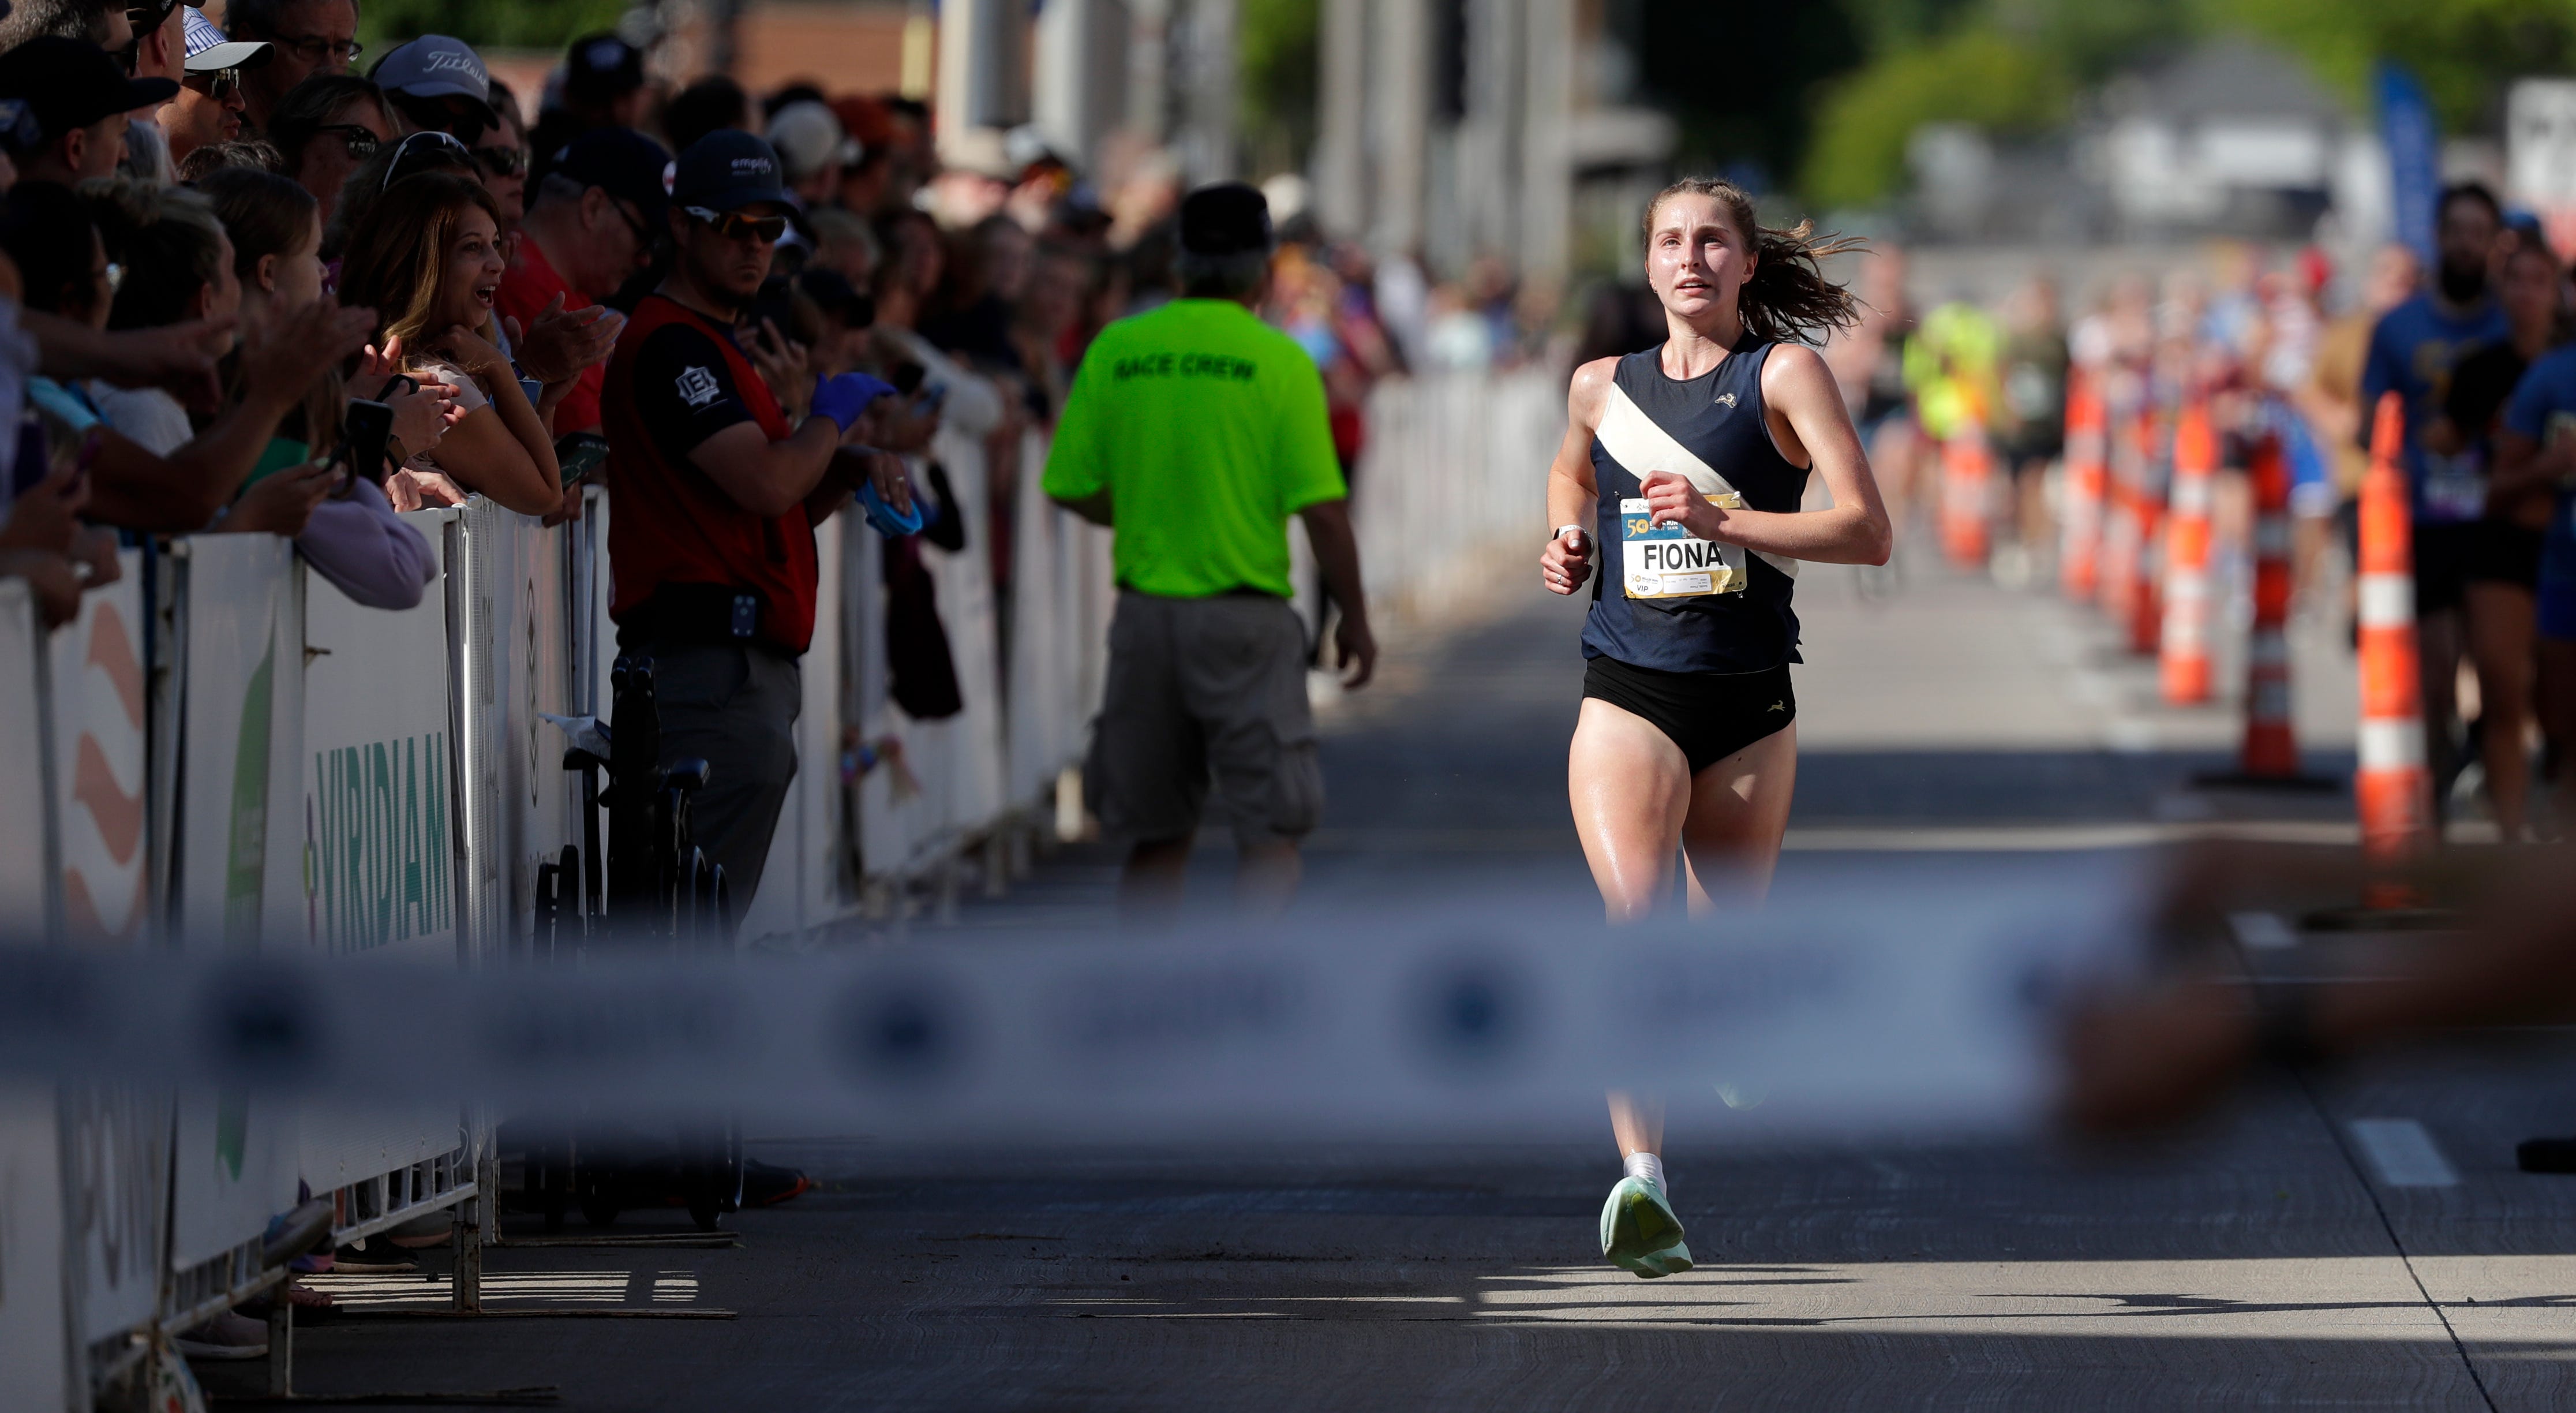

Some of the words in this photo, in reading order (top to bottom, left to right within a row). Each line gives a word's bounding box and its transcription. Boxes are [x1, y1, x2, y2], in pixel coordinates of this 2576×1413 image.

[1114, 353, 1174, 382] RACE
[1181, 353, 1257, 382] CREW
[1643, 541, 1724, 570] FIONA
[316, 731, 450, 958] VIRIDIAM
